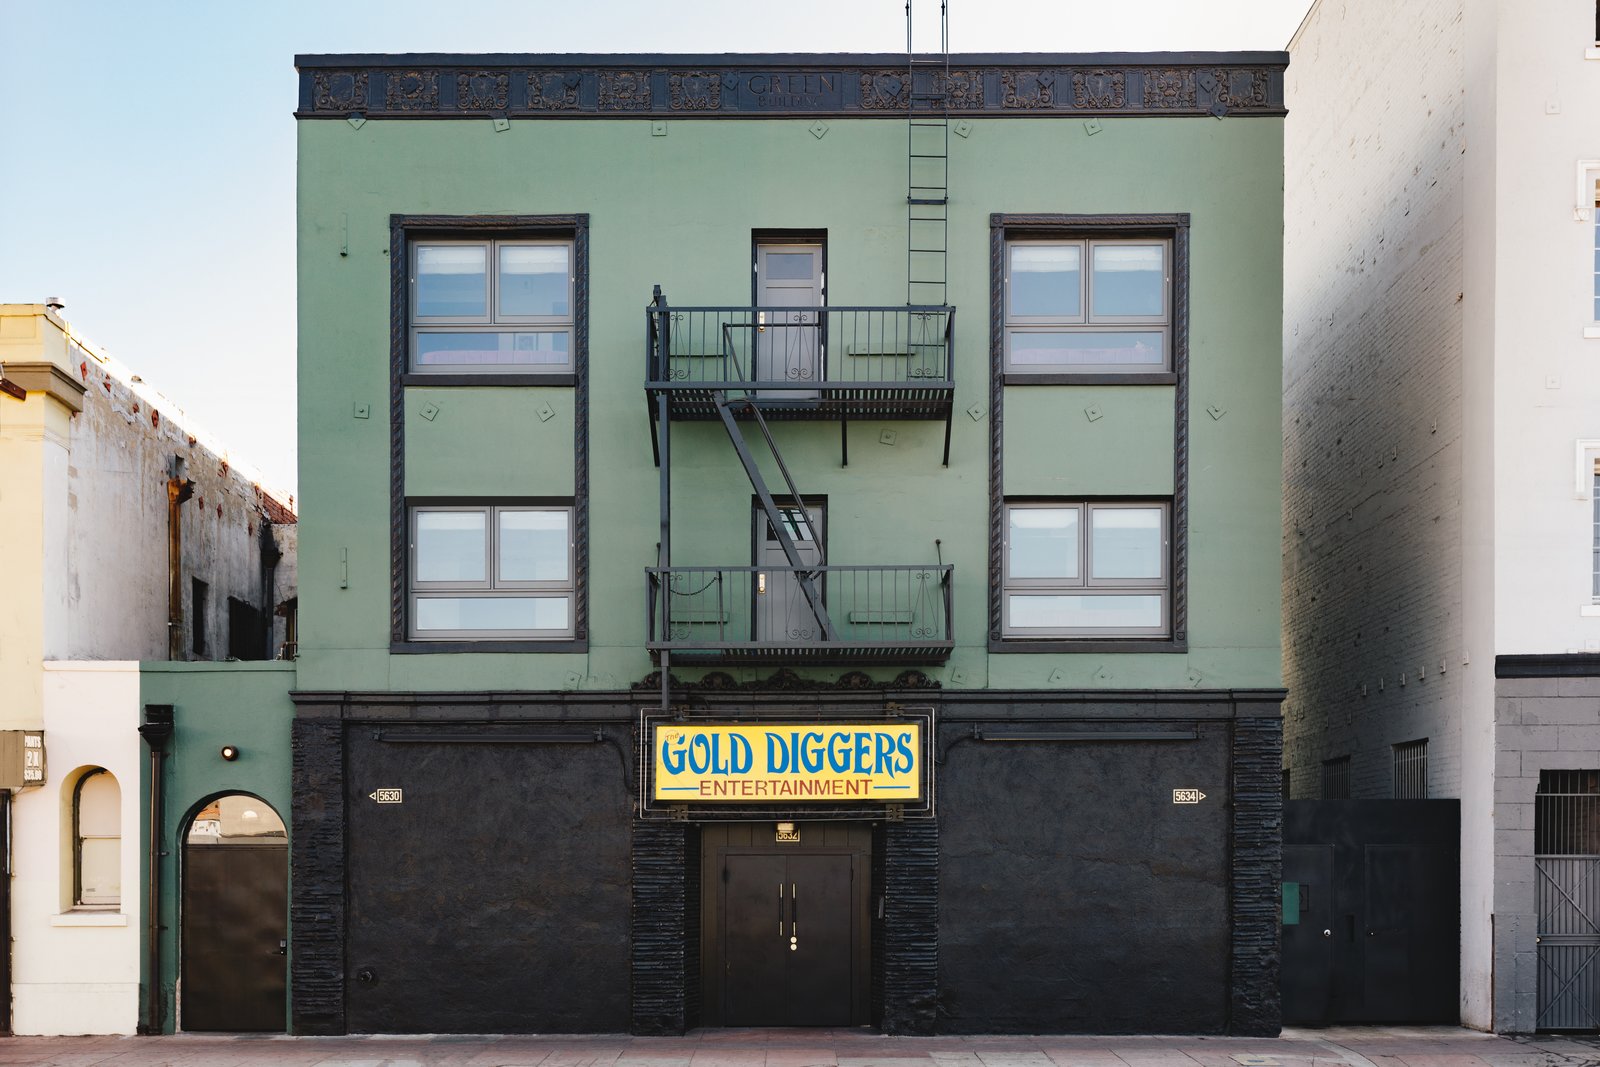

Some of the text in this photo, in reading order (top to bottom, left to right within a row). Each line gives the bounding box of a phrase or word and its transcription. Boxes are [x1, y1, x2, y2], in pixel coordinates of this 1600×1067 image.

[747, 74, 835, 95] GREEN
[24, 735, 41, 748] PANTS
[662, 732, 914, 779] GOLD DIGGERS
[700, 779, 873, 796] ENTERTAINMENT
[379, 791, 400, 801] 5630
[1175, 791, 1196, 801] 5634
[778, 831, 798, 840] 5632
